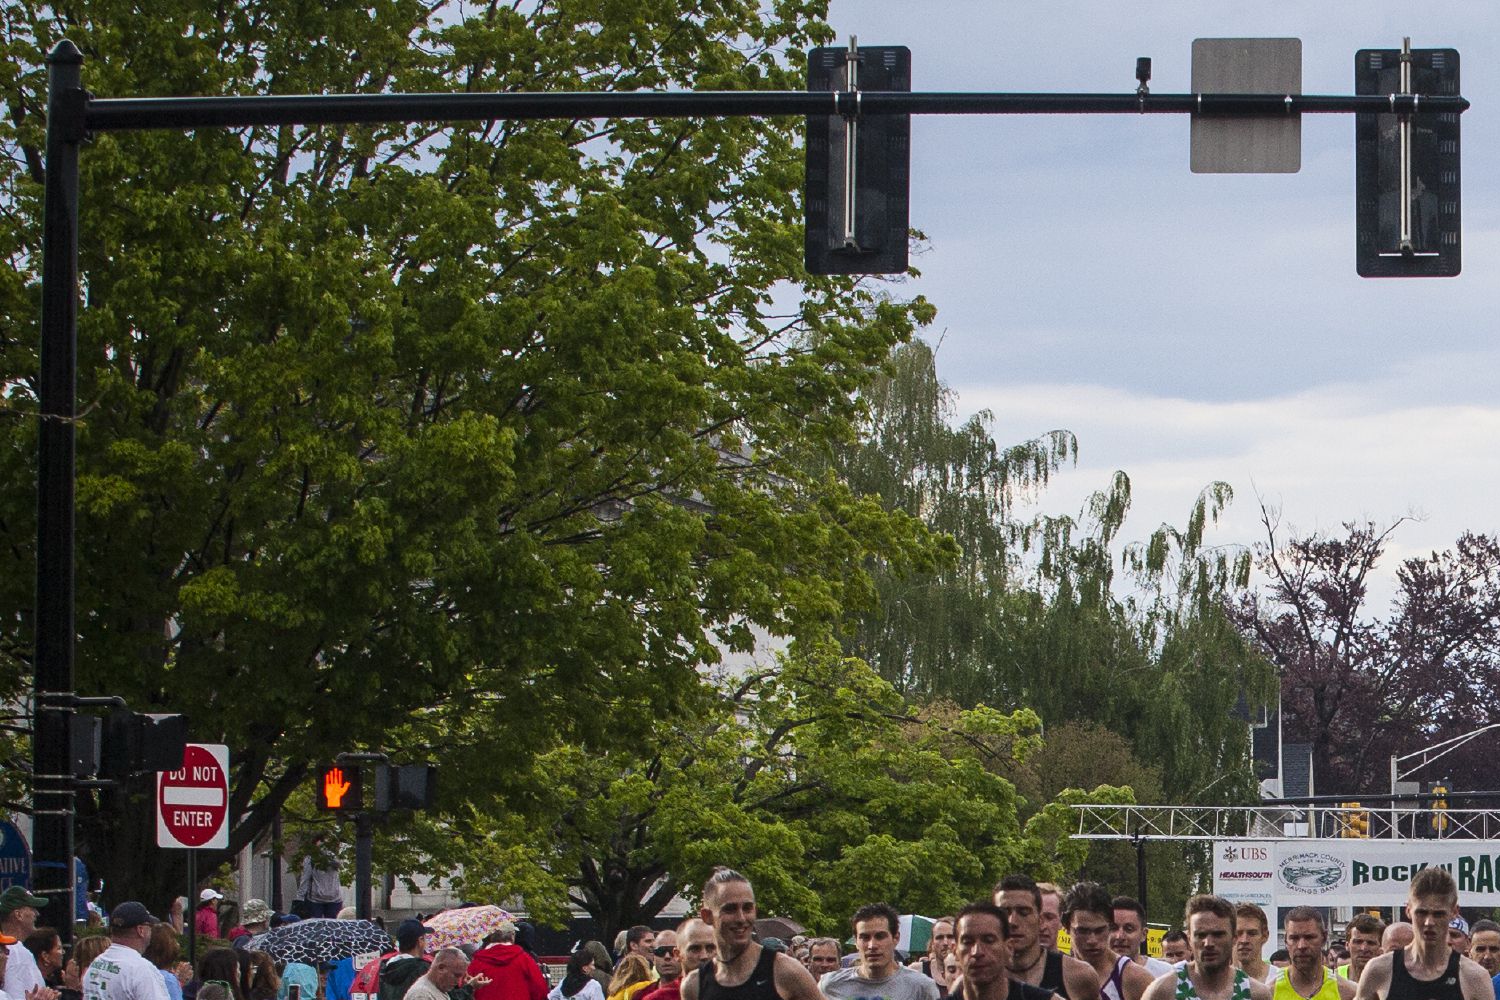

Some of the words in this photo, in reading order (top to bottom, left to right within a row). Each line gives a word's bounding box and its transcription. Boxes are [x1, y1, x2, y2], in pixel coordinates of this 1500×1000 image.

[193, 766, 218, 782] NOT
[173, 811, 213, 827] ENTER
[1240, 847, 1268, 860] UBS
[1279, 852, 1319, 869] MERRIMACK
[1320, 853, 1346, 869] COUNTY
[1219, 871, 1273, 879] HEALTHSOUTH
[1352, 859, 1429, 886] ROCK
[1285, 883, 1318, 895] SAVINGS
[1320, 884, 1340, 894] BANK
